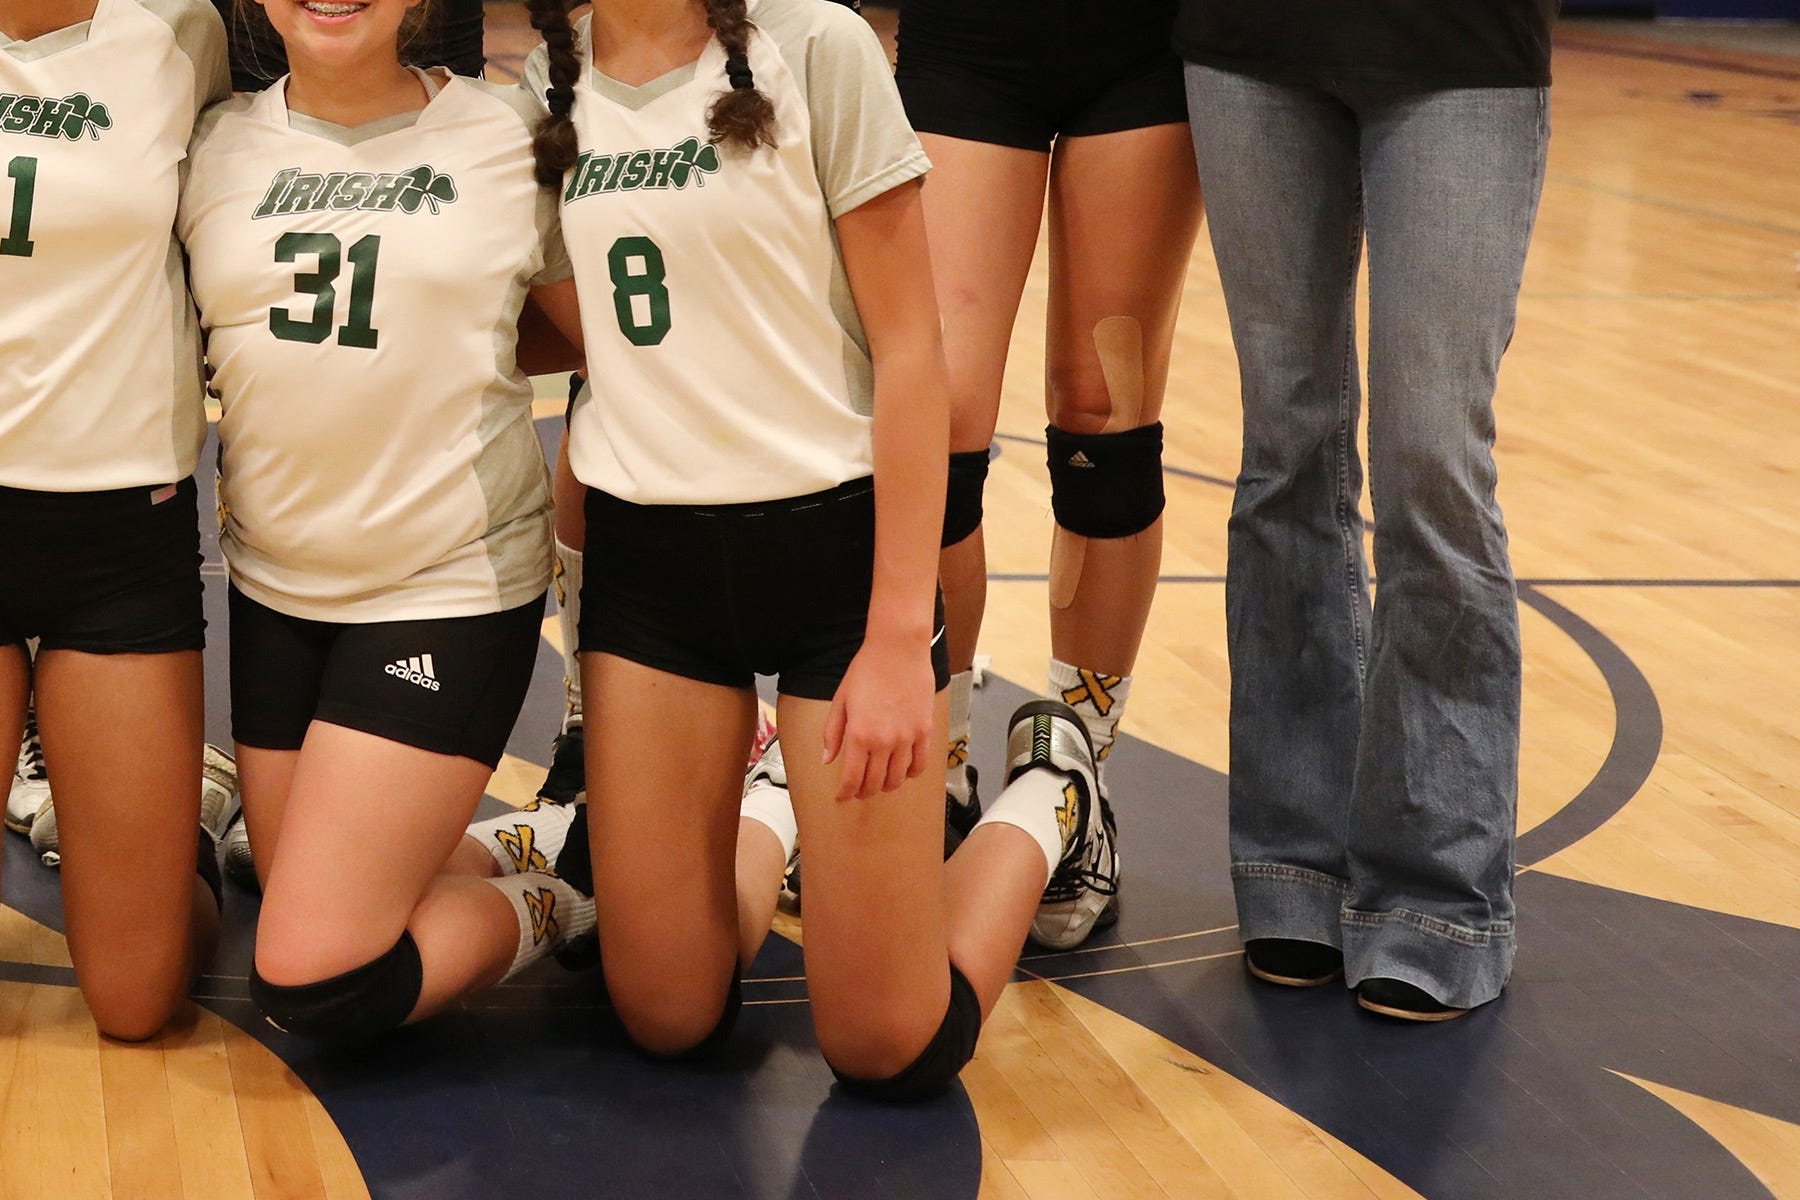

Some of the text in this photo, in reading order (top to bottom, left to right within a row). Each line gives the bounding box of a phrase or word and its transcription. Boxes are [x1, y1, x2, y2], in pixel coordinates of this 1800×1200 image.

[251, 167, 414, 220] IRISH
[563, 149, 684, 206] IRISH
[269, 232, 380, 349] 31
[607, 236, 671, 346] 8
[384, 663, 441, 692] adidas
